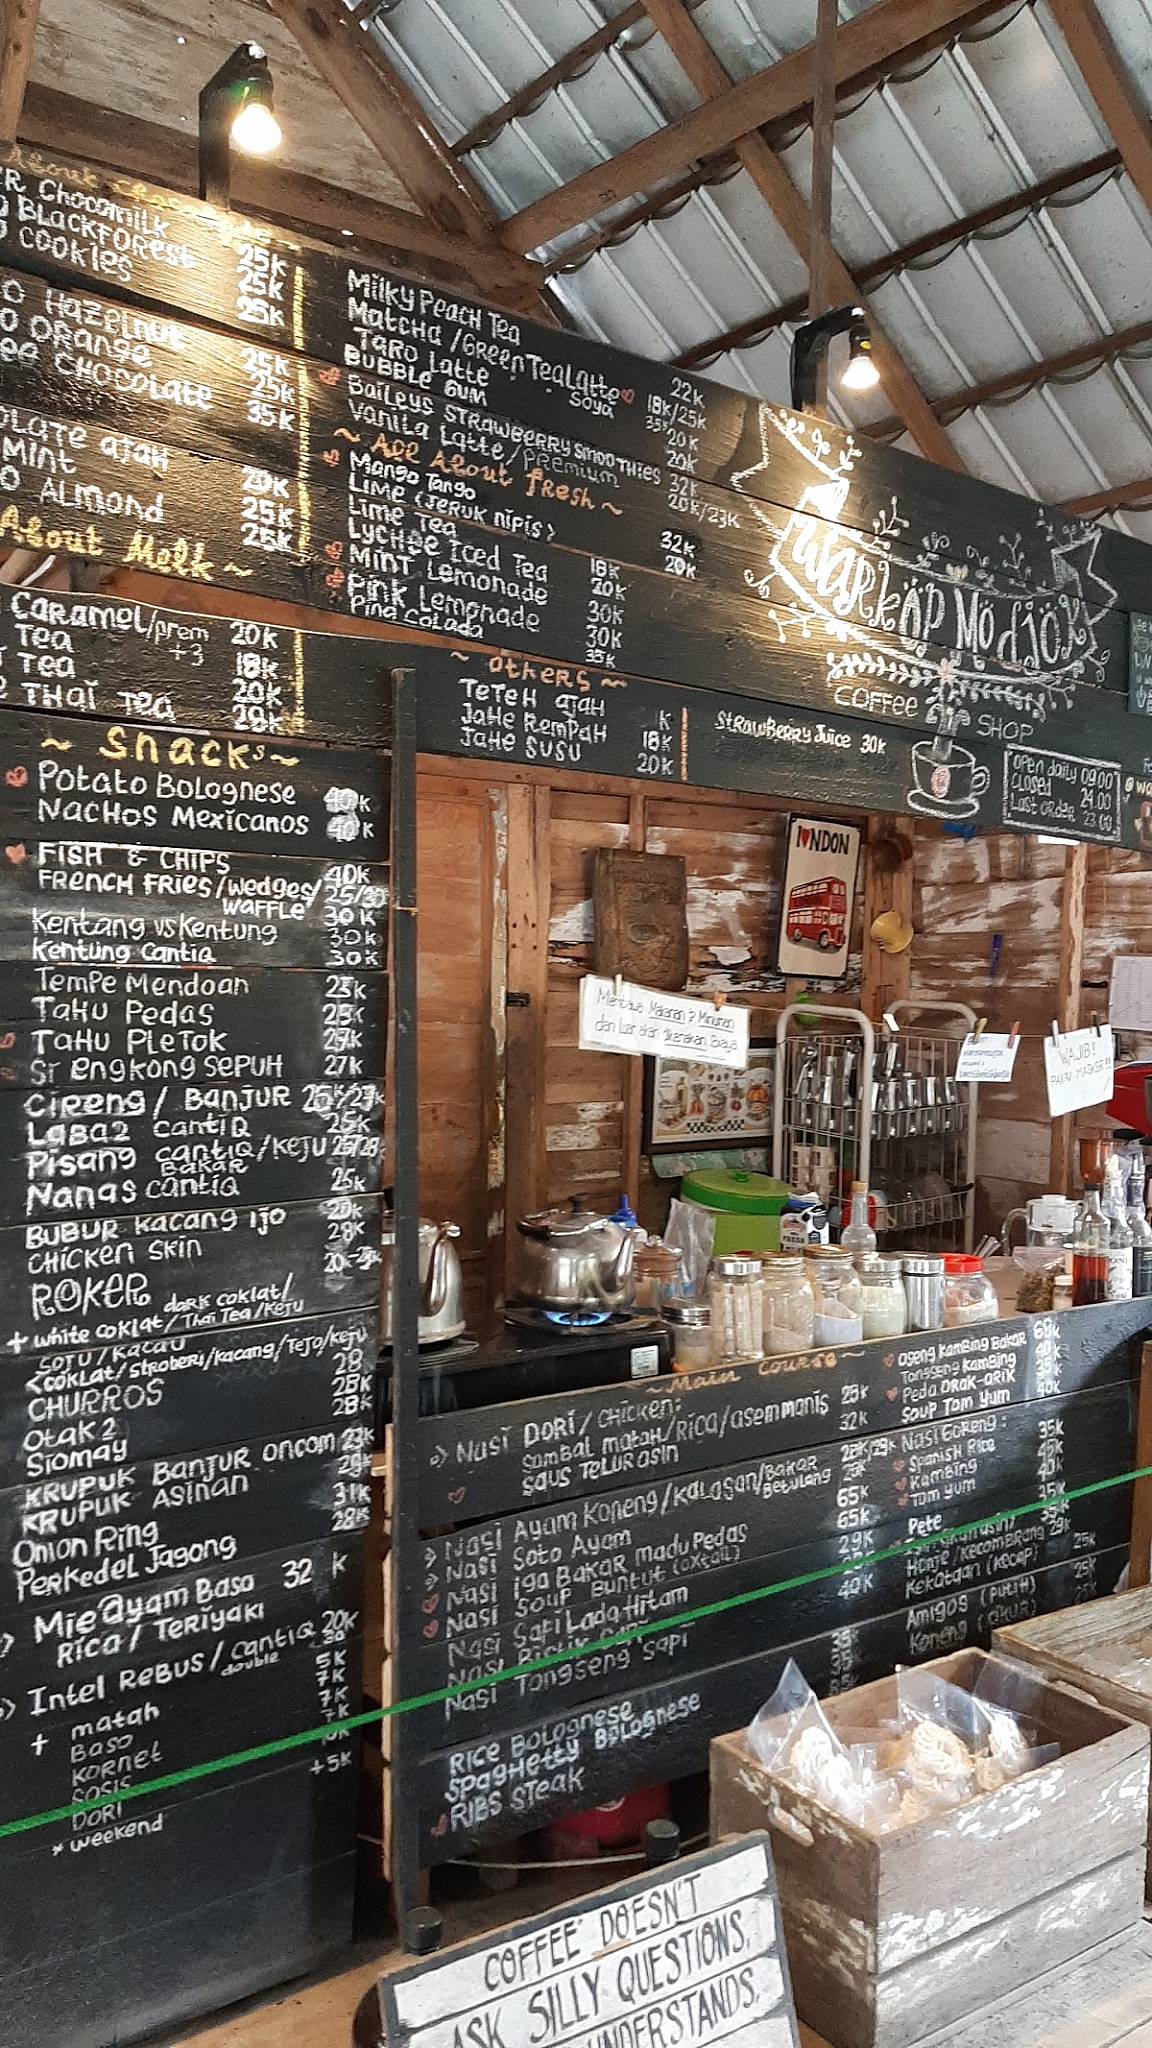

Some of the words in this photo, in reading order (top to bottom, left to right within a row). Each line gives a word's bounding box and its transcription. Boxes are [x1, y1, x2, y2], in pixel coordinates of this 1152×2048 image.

[977, 715, 1034, 741] SHOP
[38, 760, 147, 794] Potato
[127, 849, 148, 867] &
[125, 972, 250, 998] Mendoan
[26, 1219, 120, 1250] BUBUR
[484, 1920, 582, 1992] COFFEE
[600, 1873, 701, 1945] DOESN'T
[528, 1966, 600, 2044] SILLY
